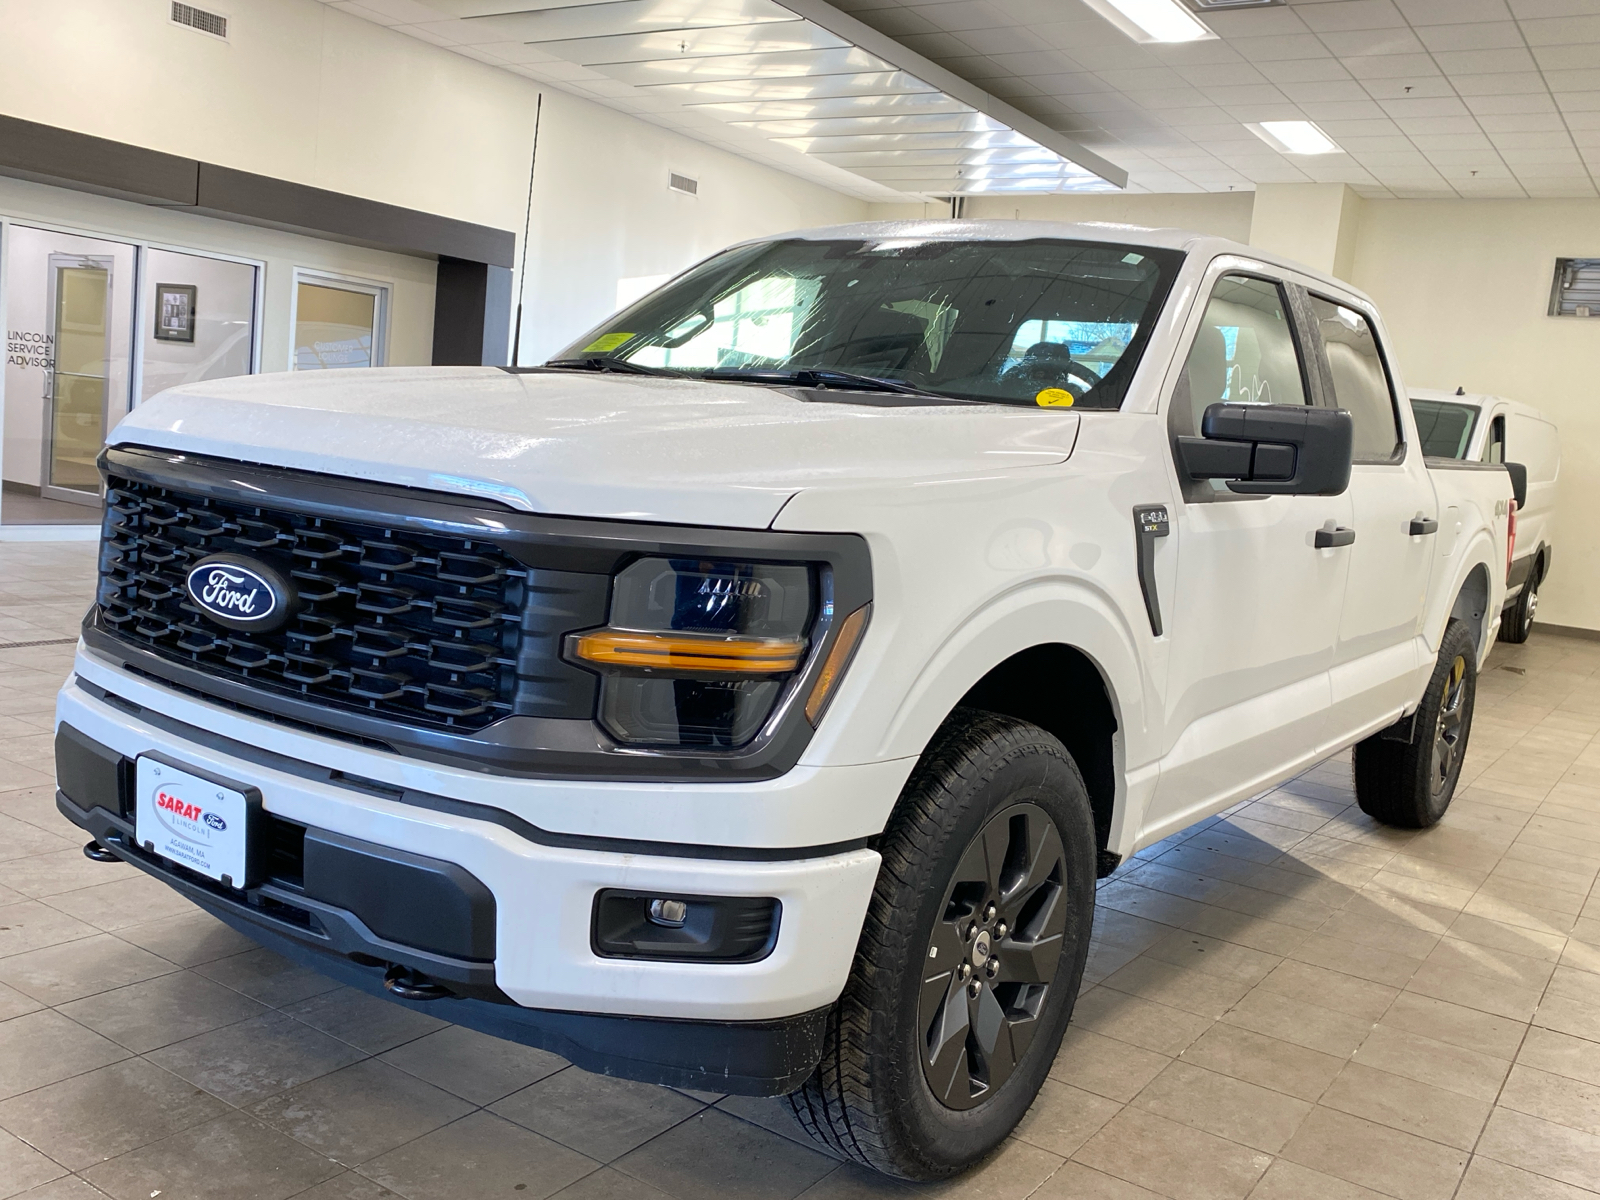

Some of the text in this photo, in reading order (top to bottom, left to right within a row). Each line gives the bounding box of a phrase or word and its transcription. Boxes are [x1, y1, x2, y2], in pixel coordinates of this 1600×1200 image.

[7, 330, 54, 344] LINCOLN
[7, 342, 50, 356] SERVICE
[314, 341, 354, 354] CUSTOMER
[7, 355, 56, 368] ADVISOR
[318, 352, 349, 363] LOUNGE
[202, 569, 258, 613] Ford
[157, 792, 202, 822] SARAT
[176, 819, 206, 835] LINCOLN
[206, 814, 225, 829] Ford
[170, 838, 206, 859] AGAWAM, MA
[164, 845, 211, 870] WWW.SARATFORD.COM
